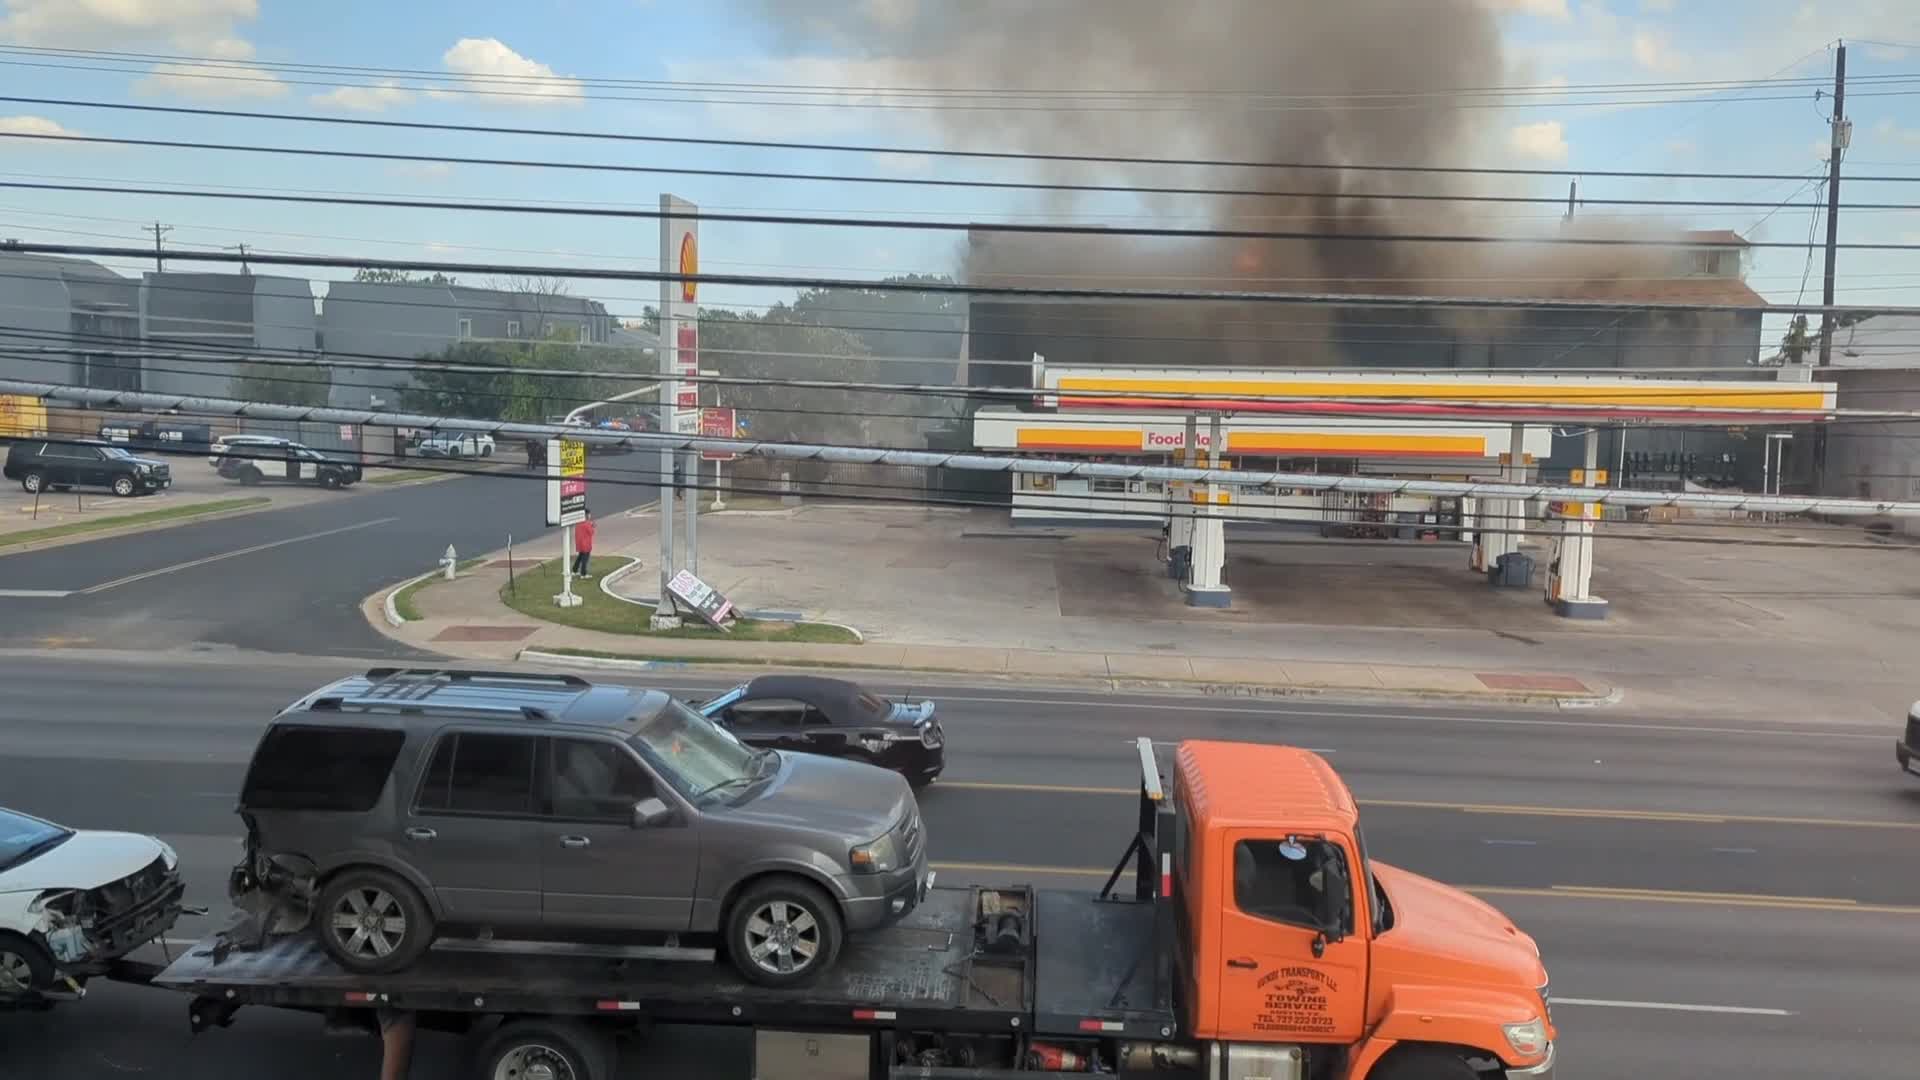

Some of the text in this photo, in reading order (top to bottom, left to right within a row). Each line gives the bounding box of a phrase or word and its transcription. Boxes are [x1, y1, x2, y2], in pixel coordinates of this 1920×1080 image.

[1148, 432, 1183, 445] Food
[1280, 967, 1326, 983] TRANSPORT
[1265, 994, 1327, 1003] TOWING
[1265, 1002, 1328, 1011] SERVICE
